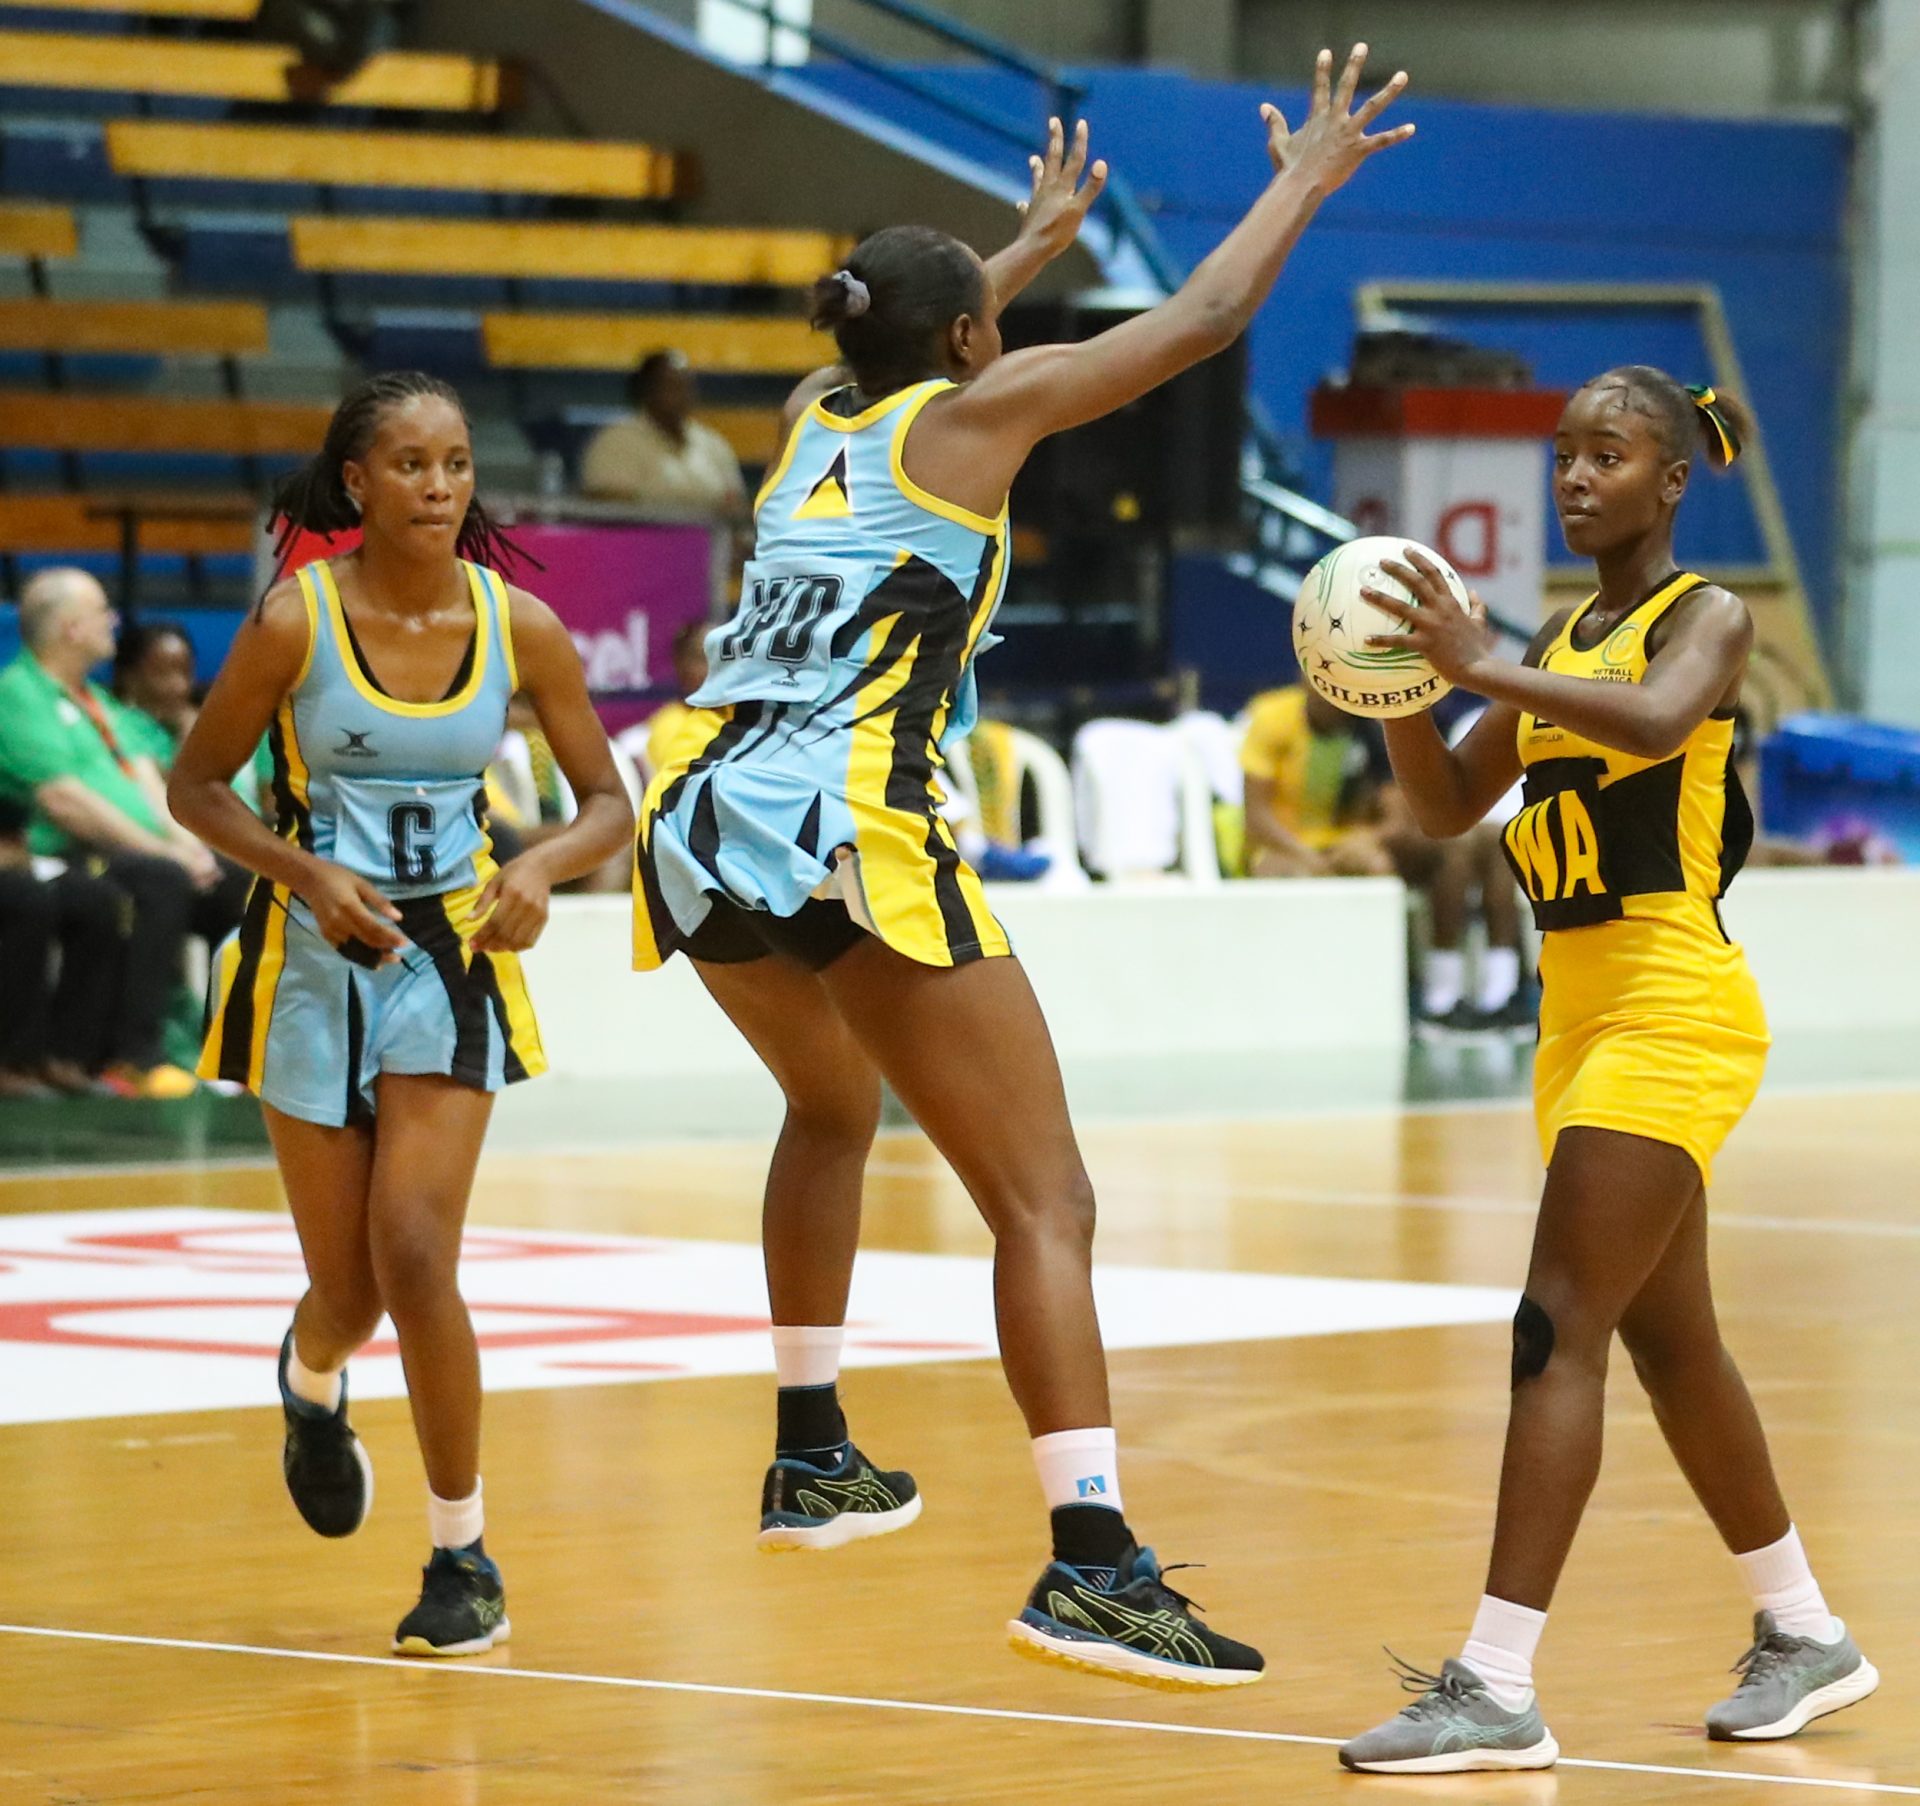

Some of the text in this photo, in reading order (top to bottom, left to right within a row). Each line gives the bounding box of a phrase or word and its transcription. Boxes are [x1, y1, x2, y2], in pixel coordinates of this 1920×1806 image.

[720, 573, 845, 664] WD
[1313, 674, 1440, 706] GILBERT
[1593, 668, 1634, 677] NETBALL
[387, 802, 437, 884] C
[1505, 789, 1608, 901] WA
